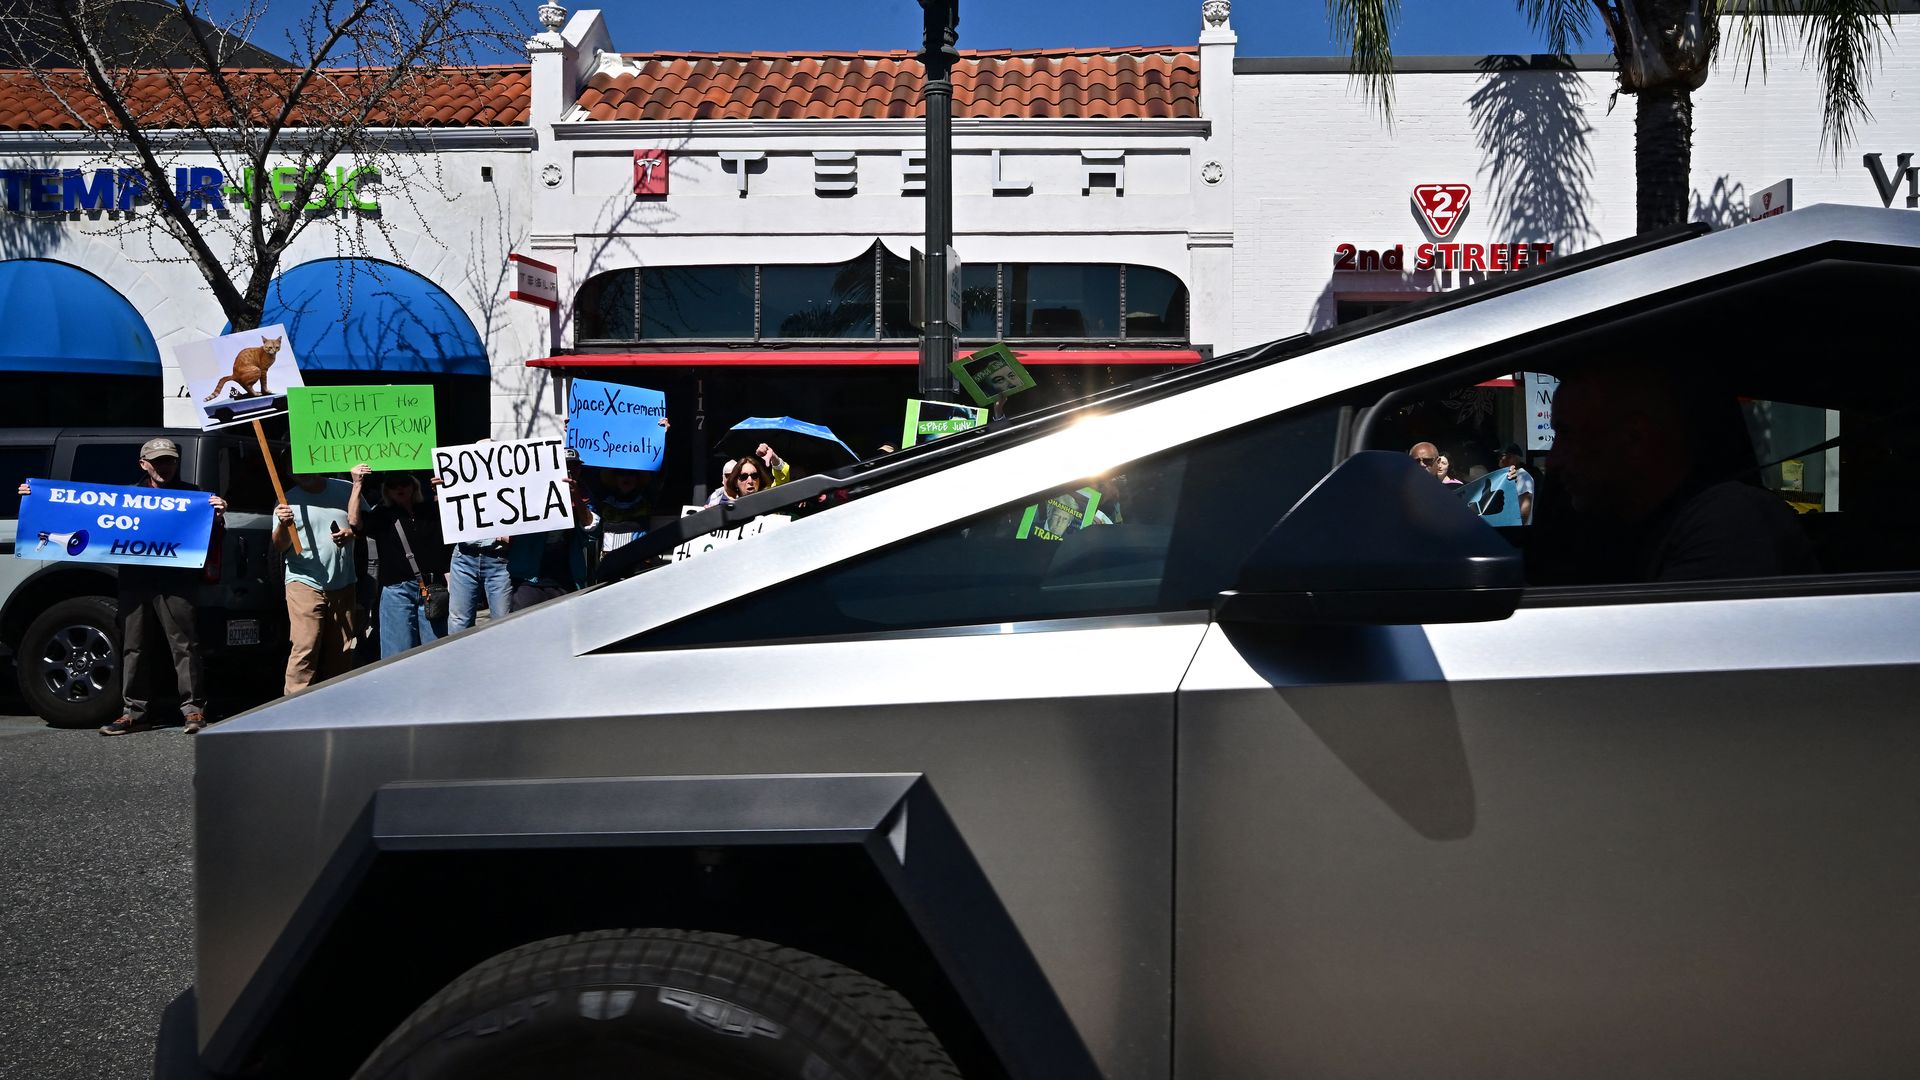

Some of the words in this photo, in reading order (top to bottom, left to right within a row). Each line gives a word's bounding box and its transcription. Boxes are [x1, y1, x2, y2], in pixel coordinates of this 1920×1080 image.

[717, 150, 1125, 193] TESLA
[1432, 191, 1453, 218] 2
[1333, 243, 1404, 271] 2nd
[1415, 243, 1554, 272] STREET
[520, 272, 556, 291] TESLA
[310, 392, 384, 414] FIGHT
[397, 394, 419, 409] the
[570, 382, 666, 419] SpaceXcrement
[313, 414, 432, 440] MUSK/TRUMP
[920, 421, 948, 432] SPACE
[308, 441, 424, 466] KLEPTOCRACY
[602, 430, 662, 462] Specialty
[436, 440, 563, 489] BOYCOTT
[49, 488, 118, 507] ELON
[122, 494, 191, 512] MUST
[445, 480, 569, 531] TESLA
[97, 514, 141, 530] GO!
[110, 538, 182, 557] HONK
